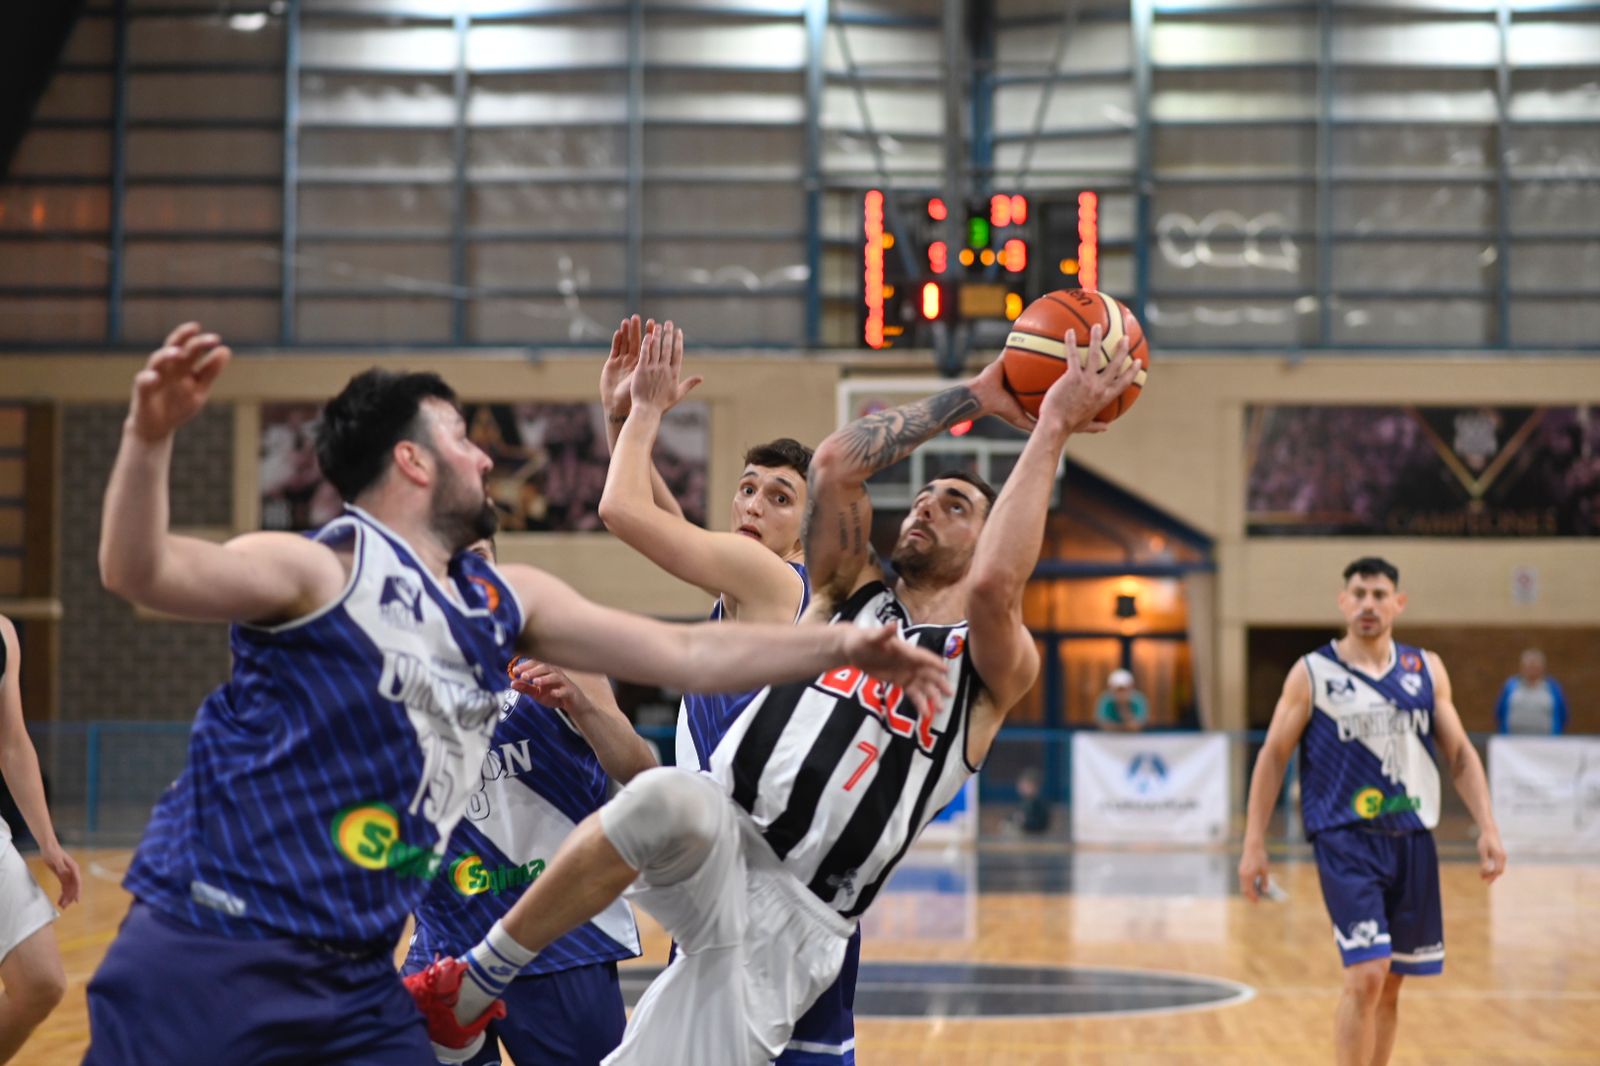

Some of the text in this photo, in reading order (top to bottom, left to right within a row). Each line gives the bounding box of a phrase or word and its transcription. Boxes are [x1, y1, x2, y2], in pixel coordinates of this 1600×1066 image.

[1337, 707, 1430, 742] UNION
[842, 740, 880, 792] 7
[1381, 738, 1401, 785] 4
